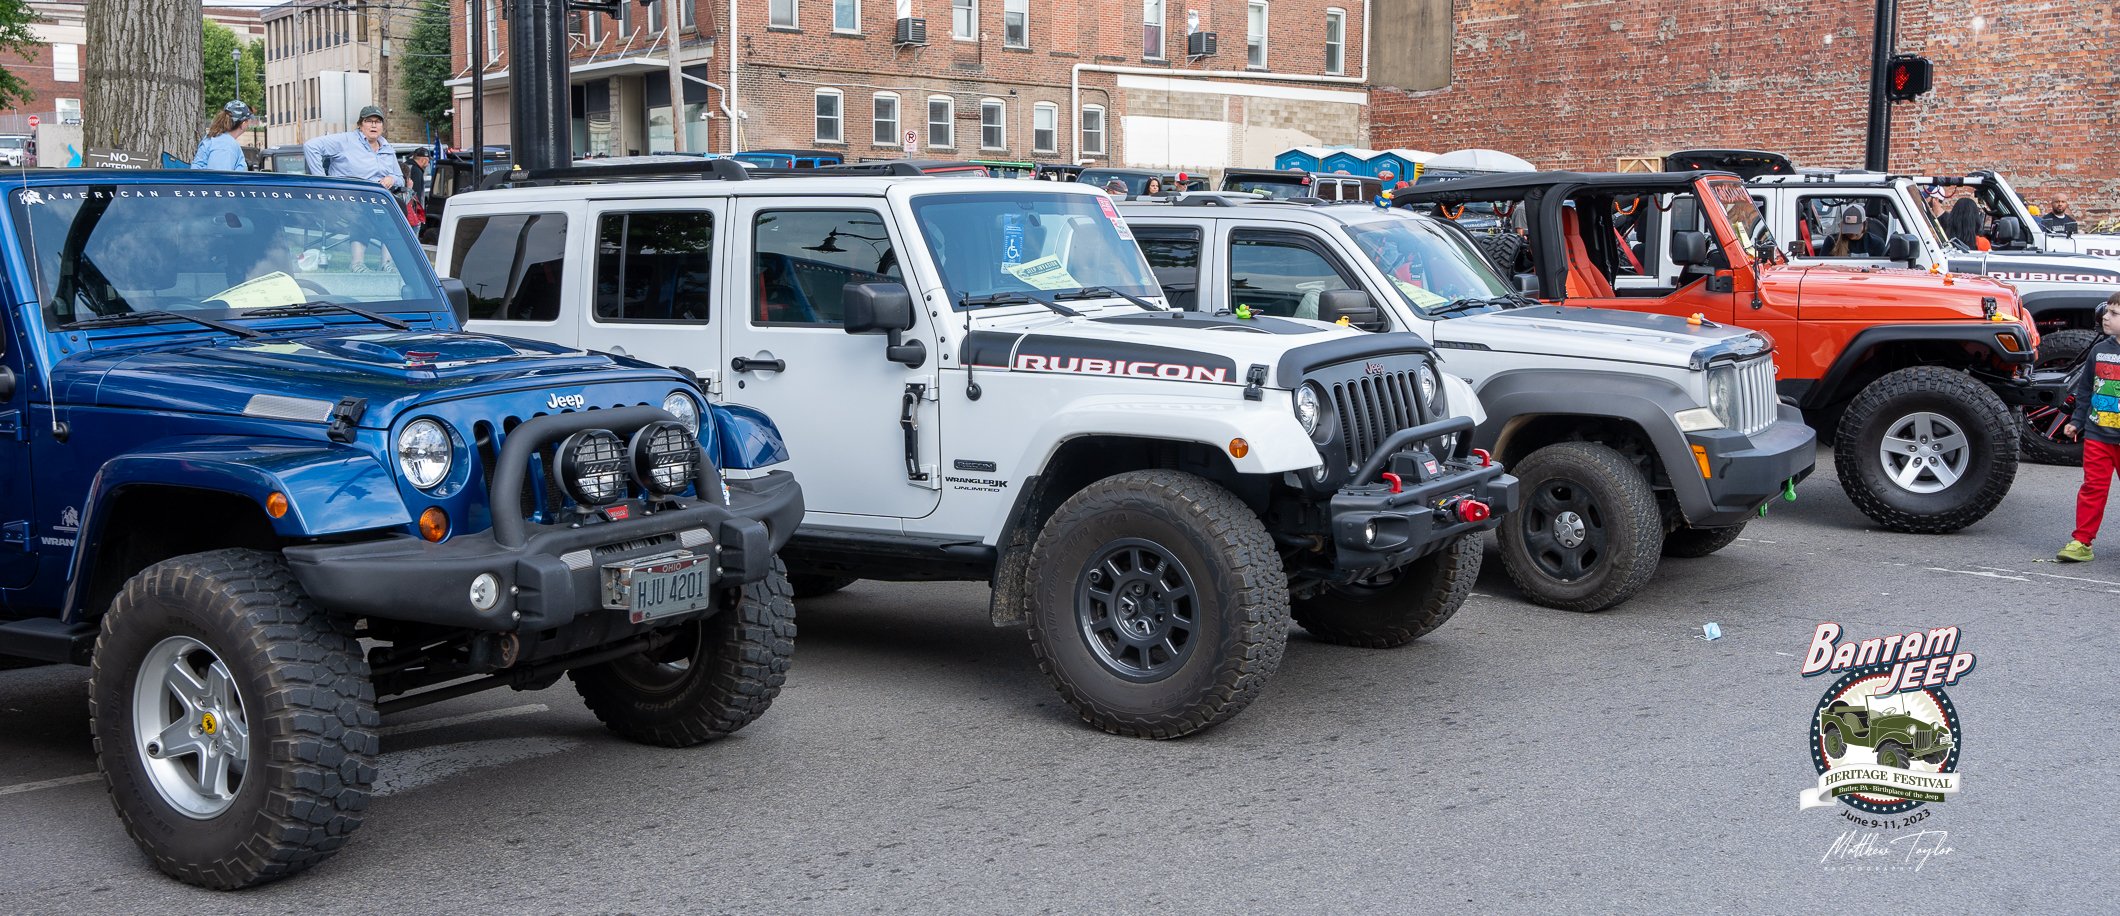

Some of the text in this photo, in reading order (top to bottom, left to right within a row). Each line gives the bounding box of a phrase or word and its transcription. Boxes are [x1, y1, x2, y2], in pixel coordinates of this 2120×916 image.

[110, 152, 129, 163] NO
[48, 190, 388, 205] AMERICAN EXPEDITION VEHICLES
[1987, 272, 2118, 283] RUBICON
[1016, 354, 1228, 382] RUBICON
[1365, 362, 1384, 375] Jeep
[547, 393, 584, 409] Jeep
[662, 562, 682, 573] OHIO
[638, 571, 703, 609] HJU 4201
